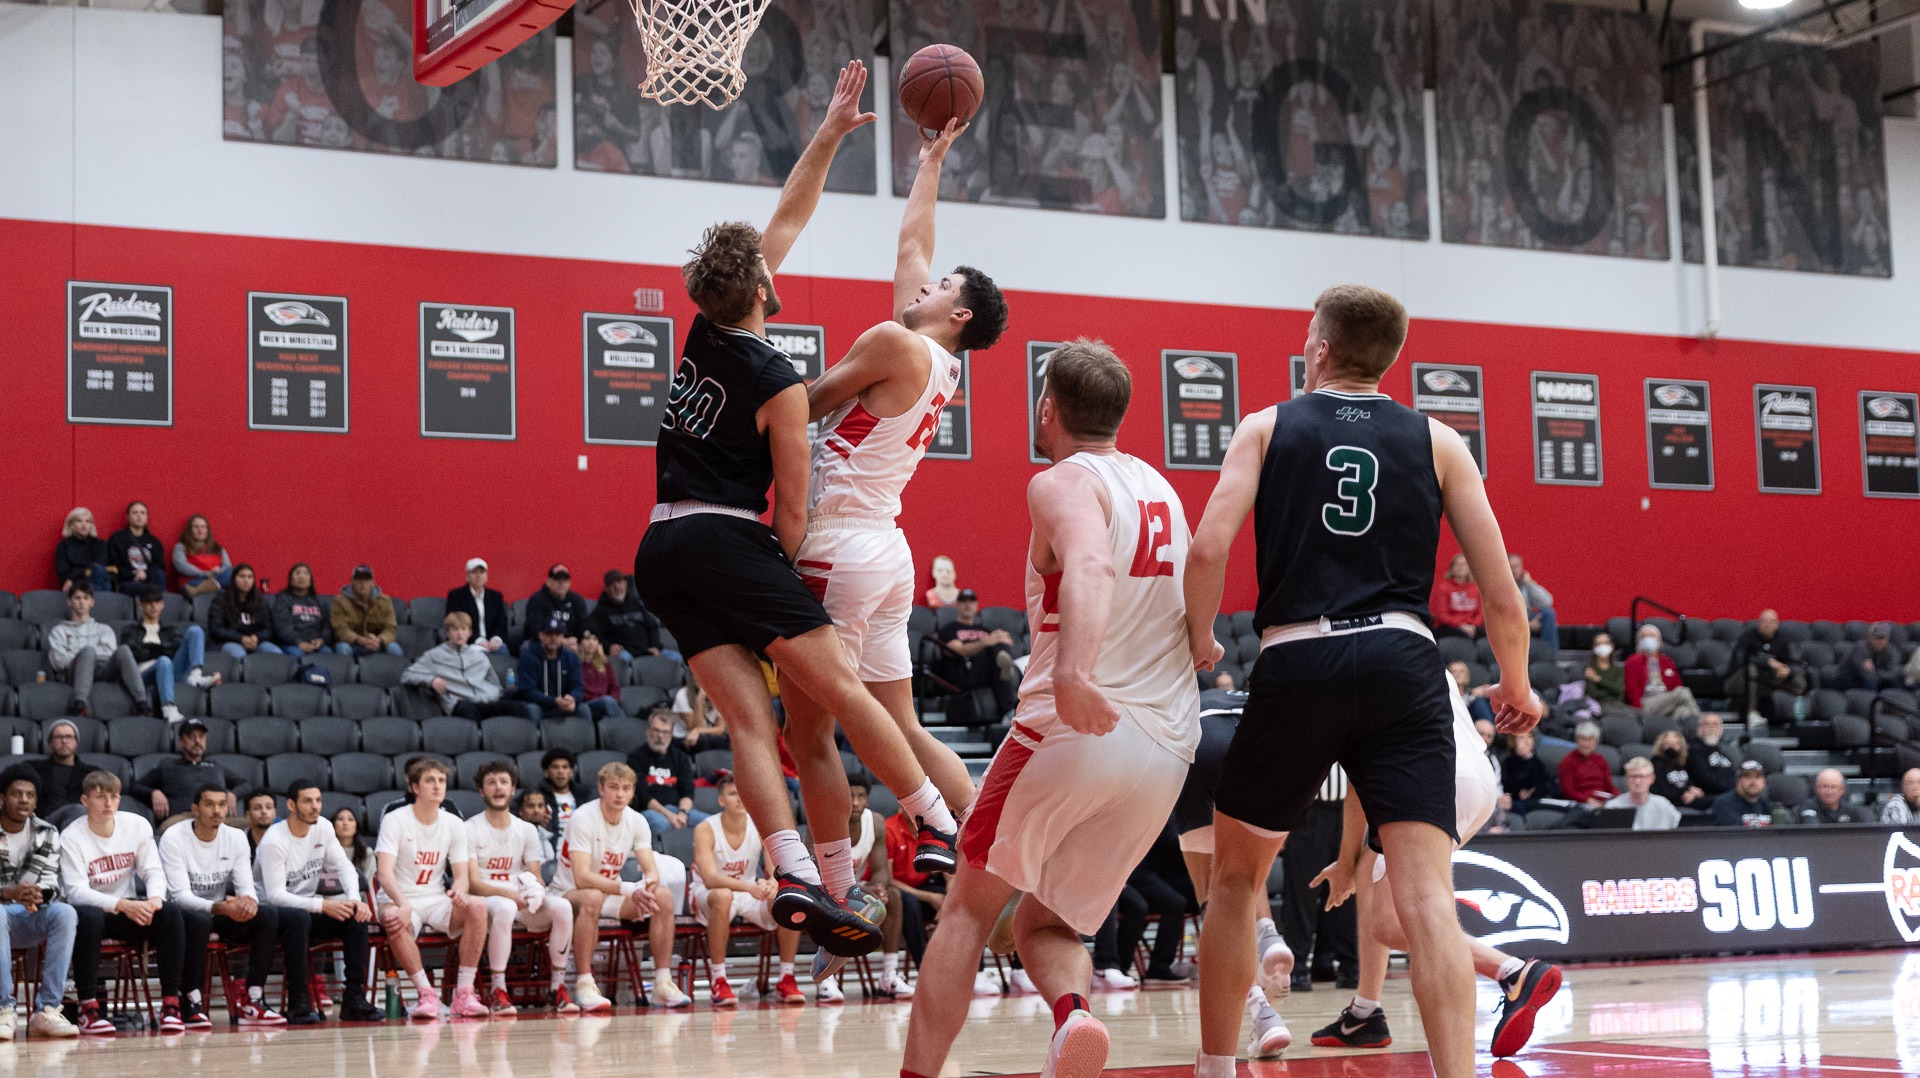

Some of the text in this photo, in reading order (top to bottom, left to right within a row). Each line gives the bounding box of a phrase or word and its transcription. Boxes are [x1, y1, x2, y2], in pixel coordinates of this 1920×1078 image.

[78, 292, 162, 321] Raiders
[435, 308, 499, 335] Raiders
[1321, 445, 1380, 538] 3
[1128, 499, 1174, 578] 12
[414, 850, 440, 866] SOU
[486, 856, 513, 871] SOU
[601, 850, 624, 867] SOU
[1581, 857, 1815, 933] RAIDERS SOU
